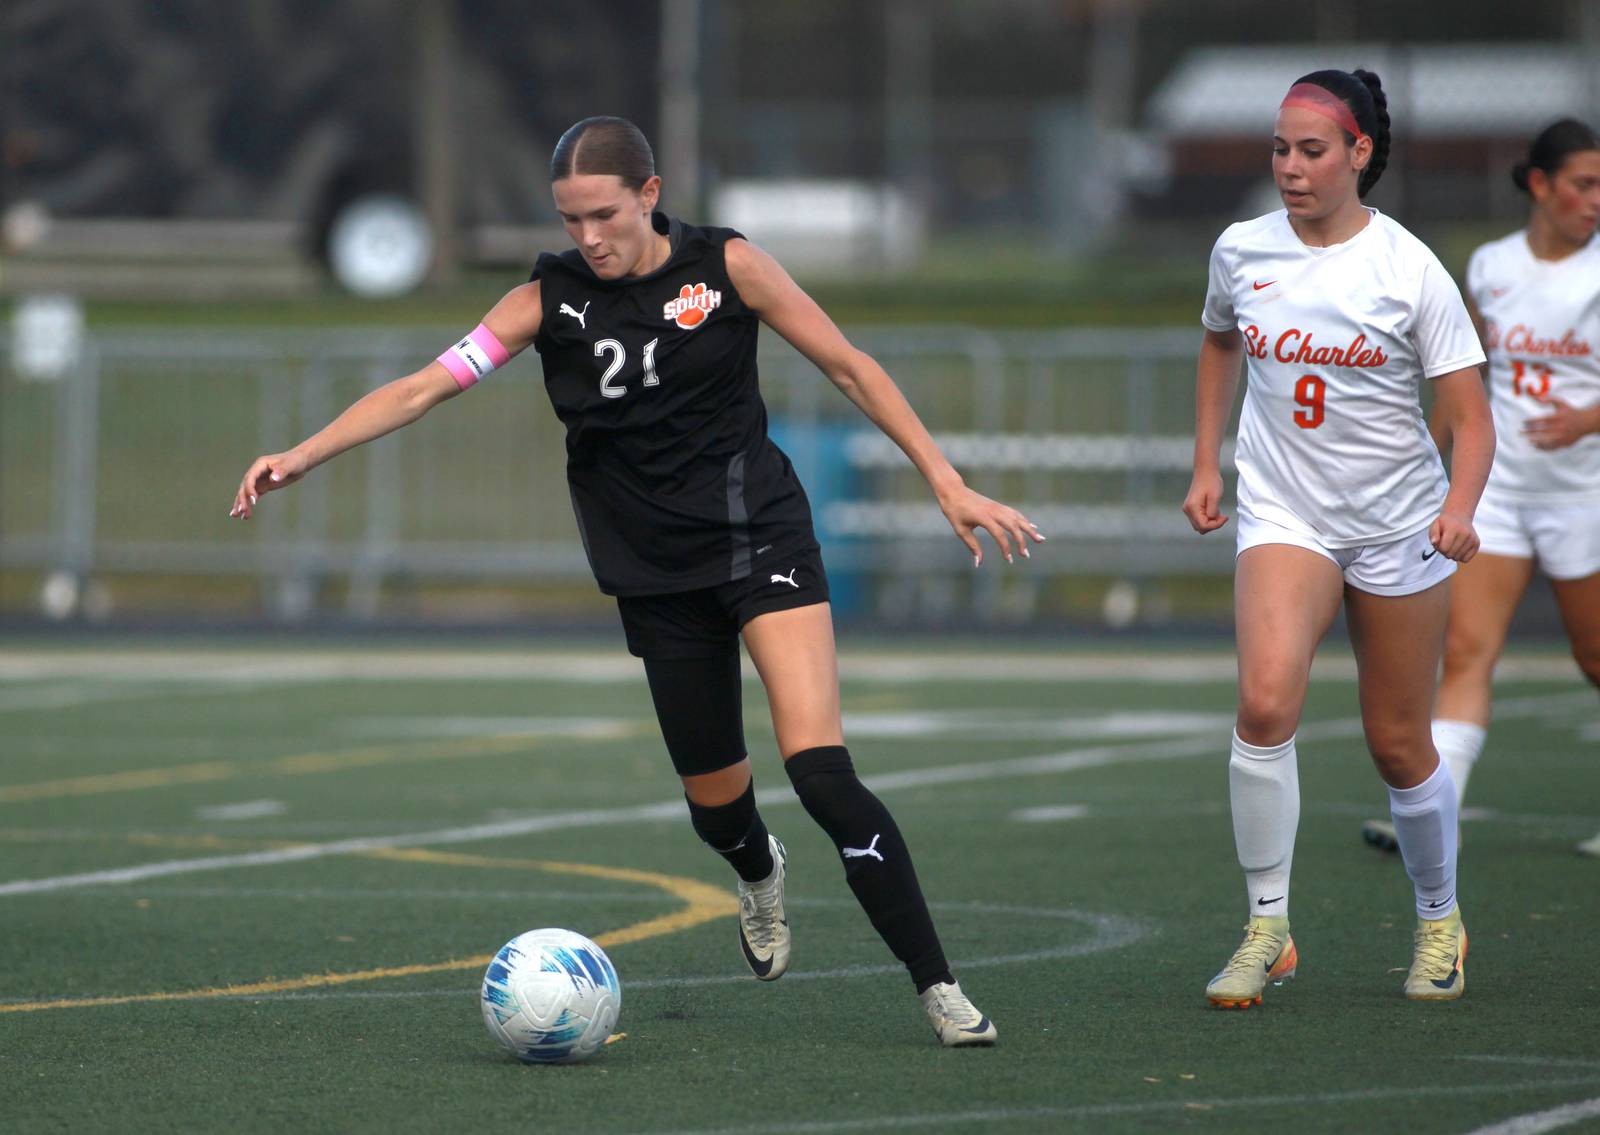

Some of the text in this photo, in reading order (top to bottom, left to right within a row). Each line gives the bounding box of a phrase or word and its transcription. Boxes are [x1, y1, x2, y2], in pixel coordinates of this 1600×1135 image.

[663, 289, 722, 320] SOUTH
[1243, 324, 1388, 368] St Charles
[594, 338, 660, 399] 21
[1511, 359, 1552, 399] 13
[1293, 374, 1326, 429] 9
